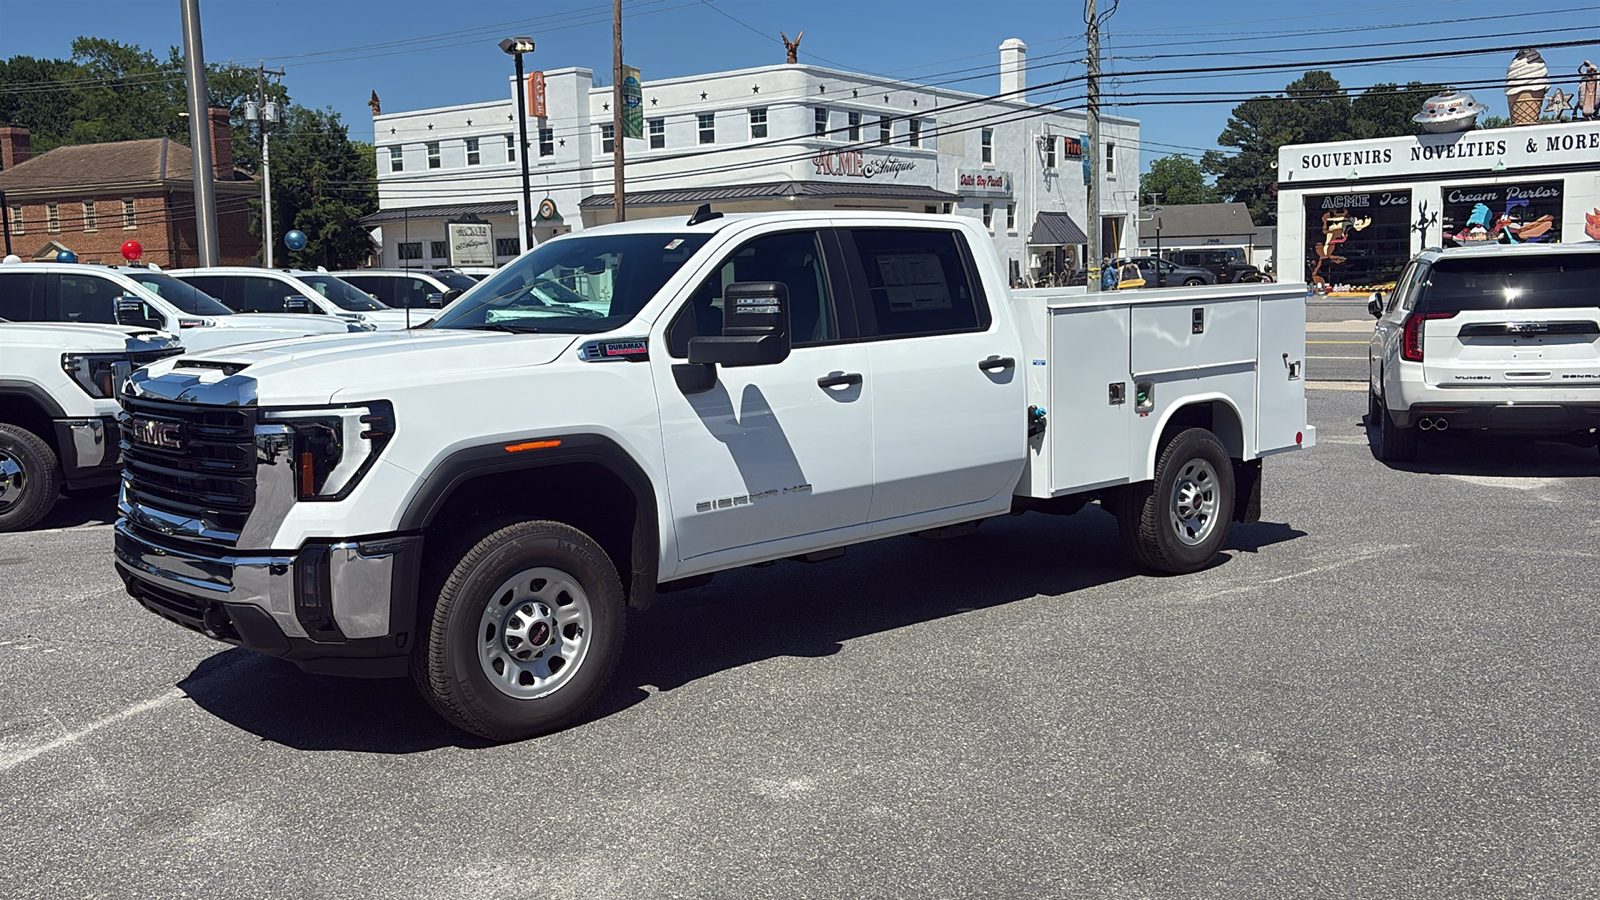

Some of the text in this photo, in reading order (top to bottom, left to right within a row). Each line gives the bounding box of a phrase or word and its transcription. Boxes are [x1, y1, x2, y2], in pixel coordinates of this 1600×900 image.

[536, 74, 544, 114] ACME
[1302, 132, 1600, 169] SOUVENIRS NOVELTIES & MORE
[812, 147, 916, 179] ACME Antiques
[960, 173, 1003, 189] Dutch Boy Paints
[1321, 192, 1409, 209] ACME Ice
[1448, 186, 1560, 204] Cream Parlor
[608, 342, 644, 351] DURAMAX
[132, 418, 181, 449] GMC
[782, 483, 813, 496] HD
